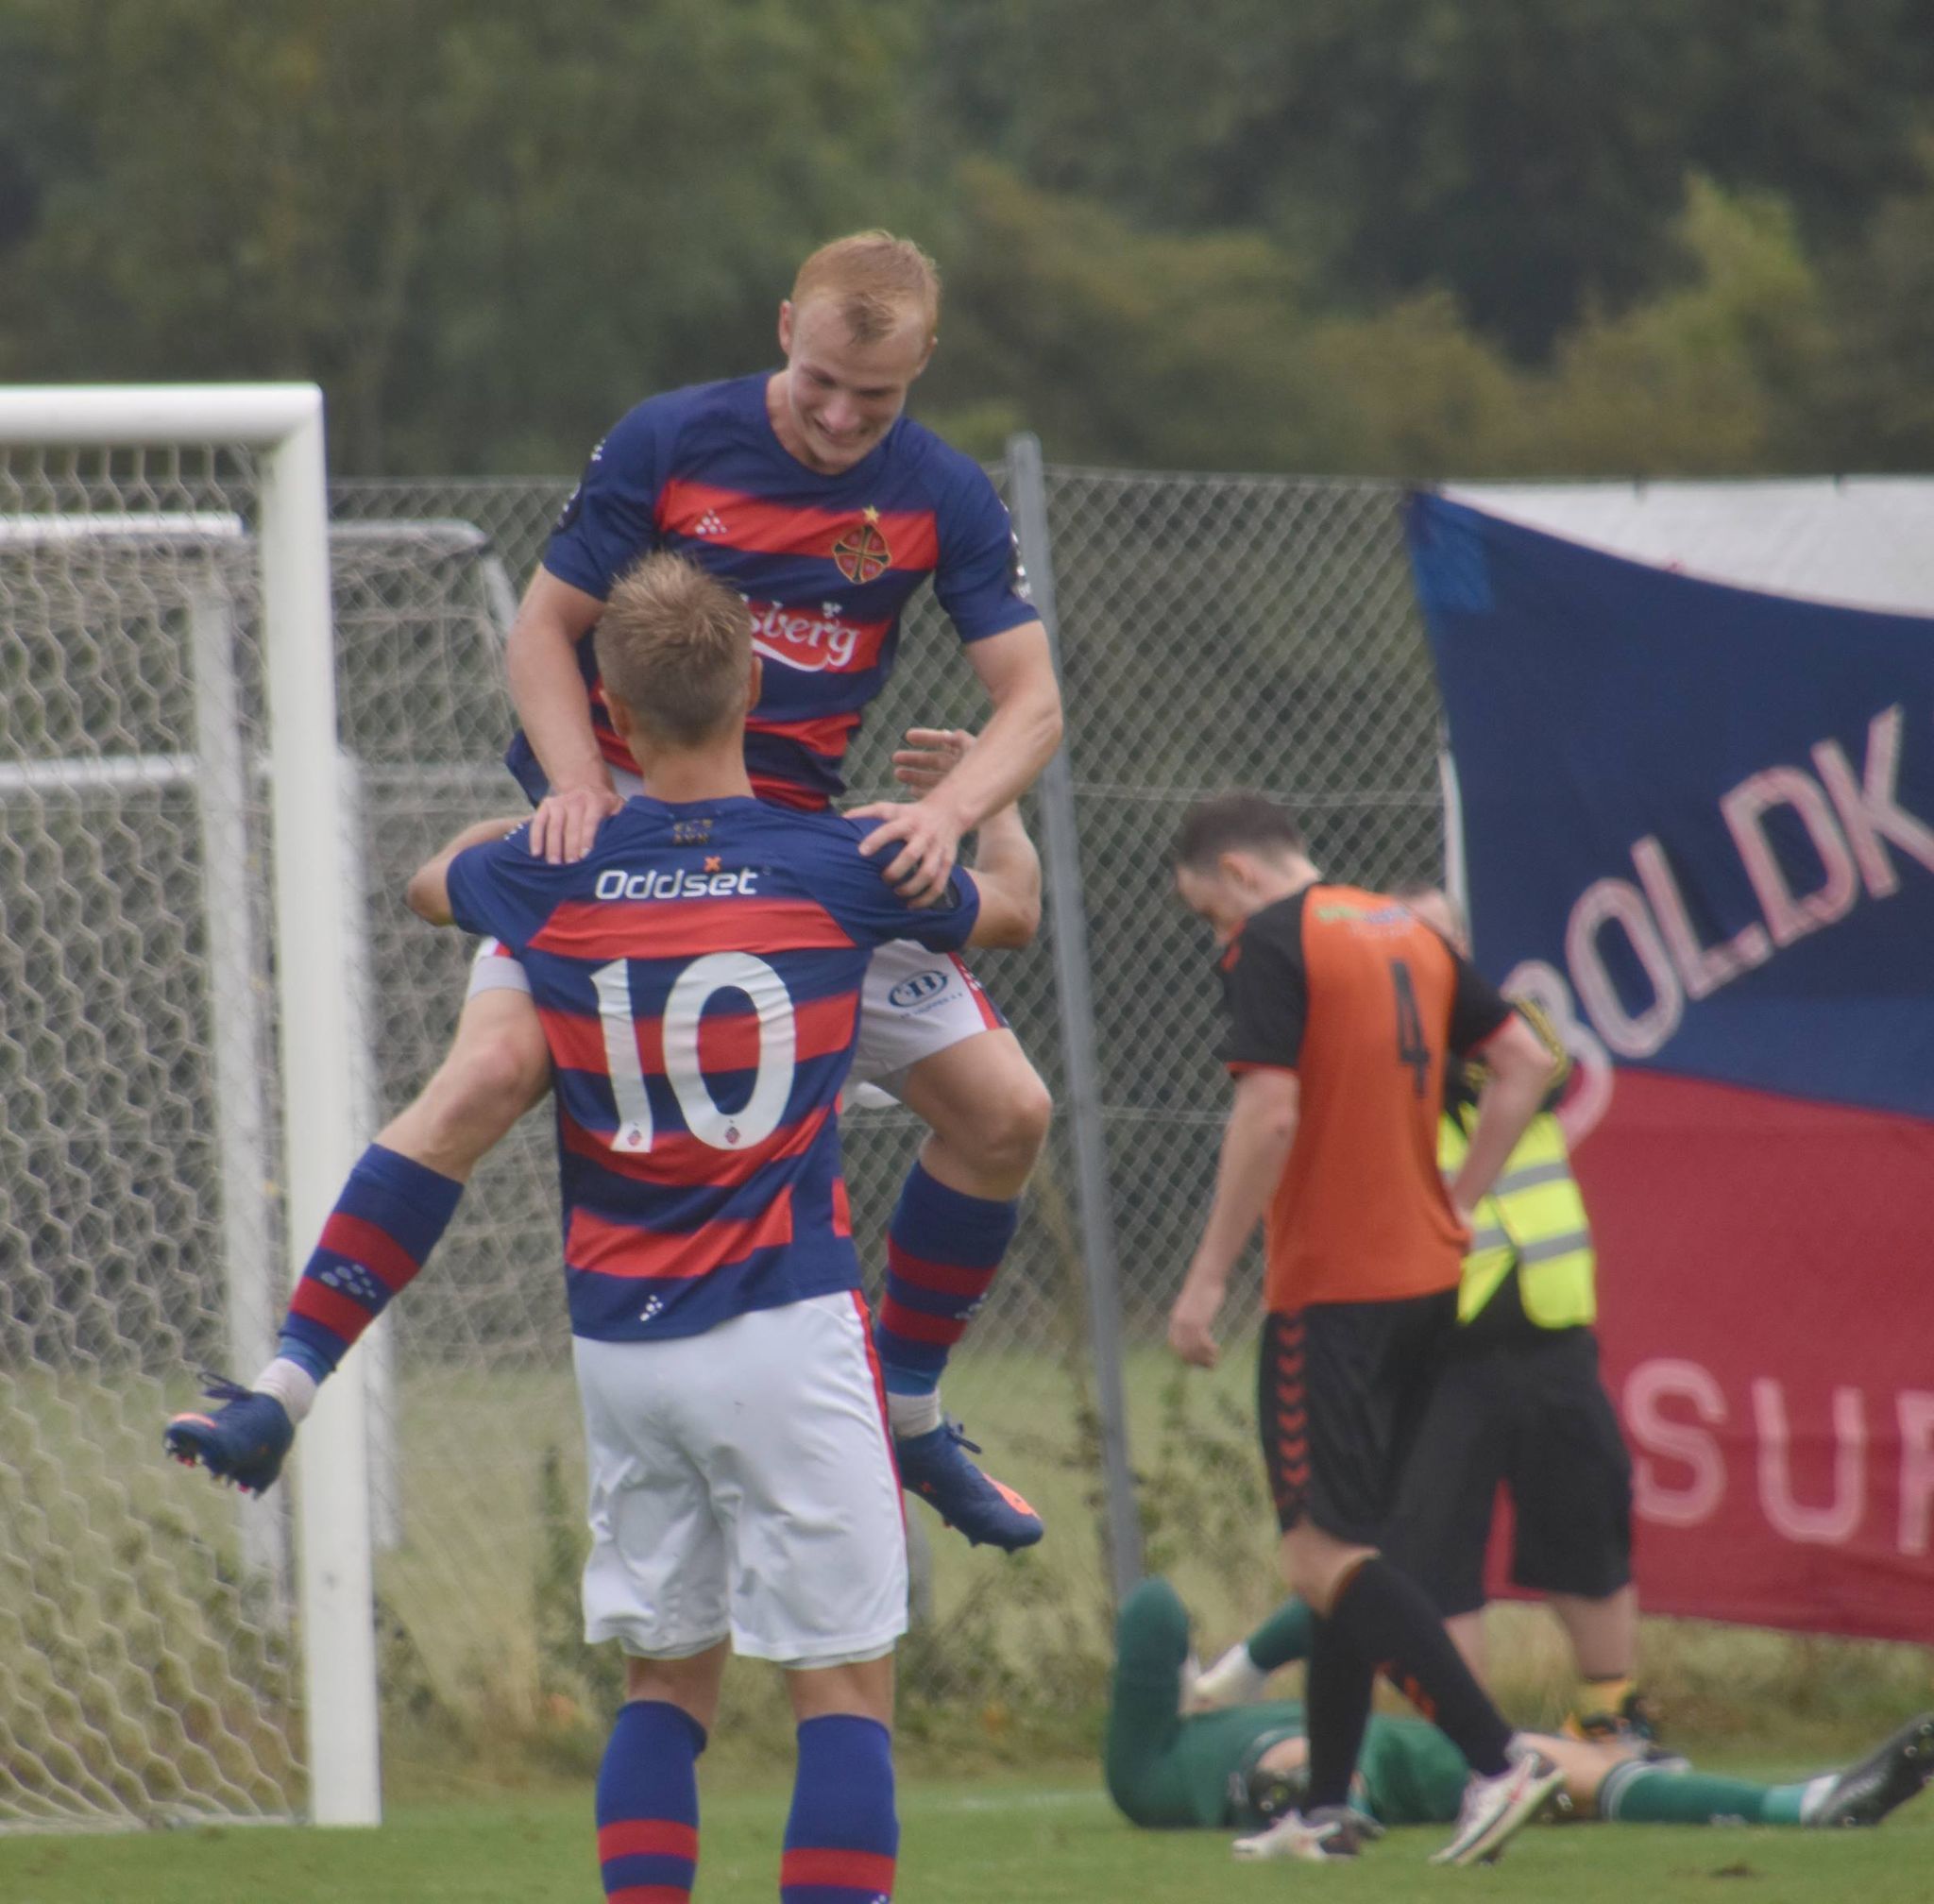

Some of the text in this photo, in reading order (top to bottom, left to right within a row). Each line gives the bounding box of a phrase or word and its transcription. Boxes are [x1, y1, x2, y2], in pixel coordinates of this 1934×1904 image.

[742, 597, 859, 670] sberg
[594, 858, 759, 900] Oddset
[589, 951, 796, 1154] 10
[1390, 960, 1431, 1099] 4
